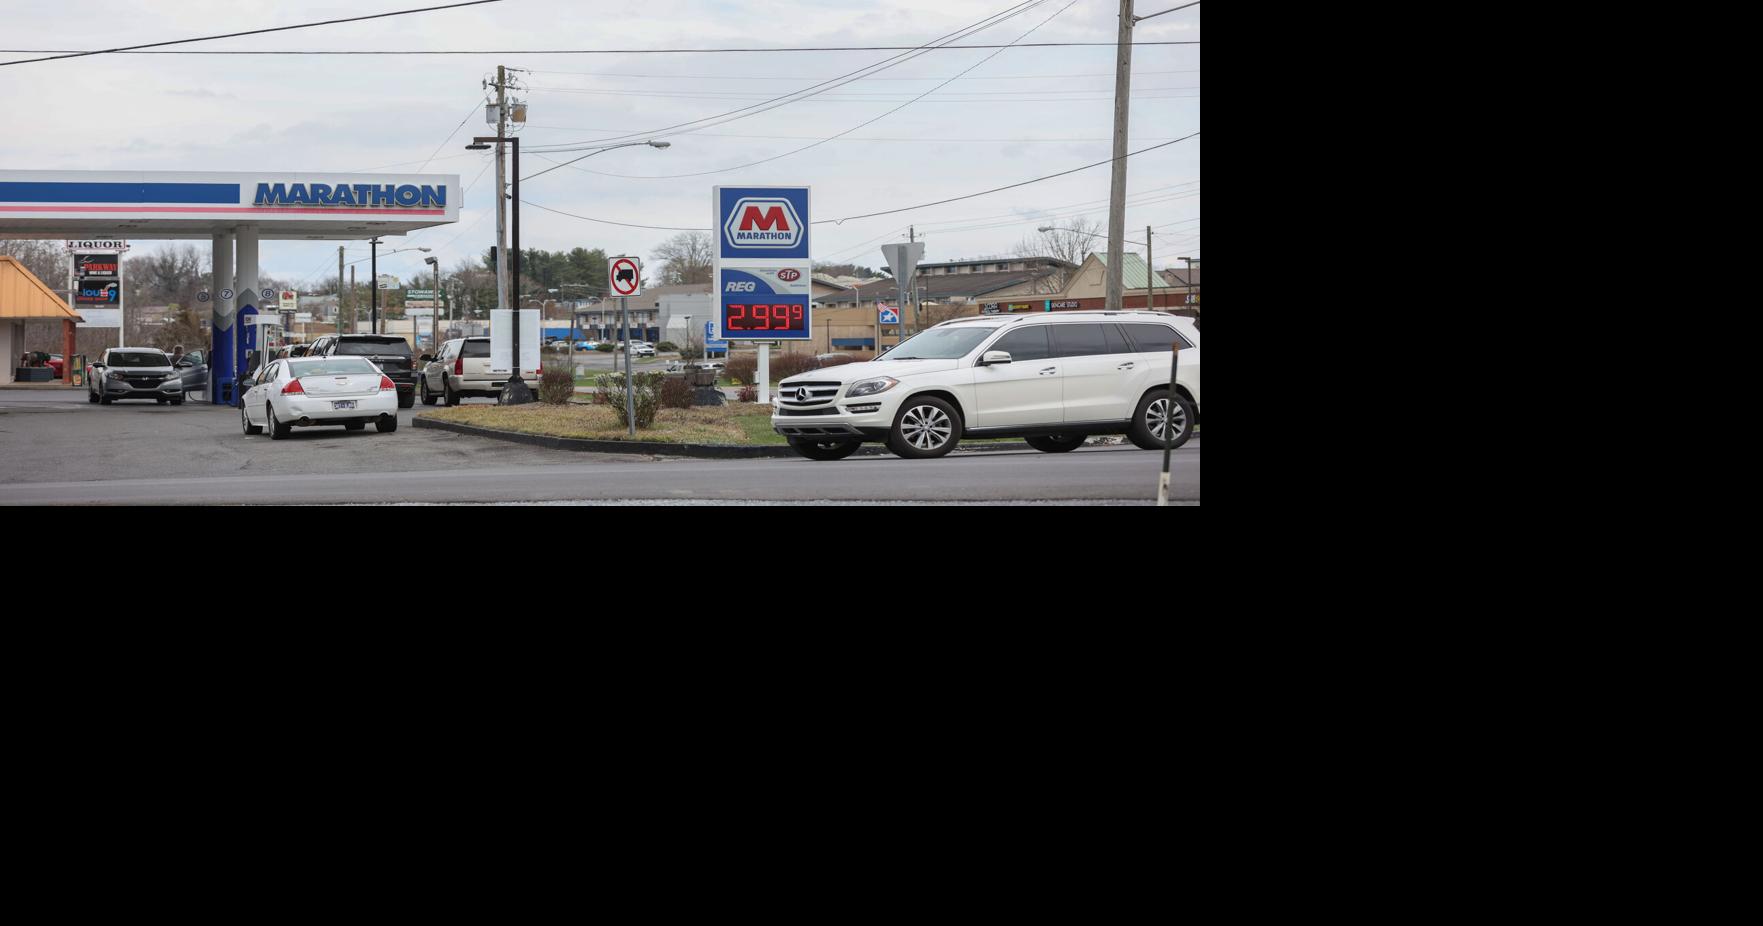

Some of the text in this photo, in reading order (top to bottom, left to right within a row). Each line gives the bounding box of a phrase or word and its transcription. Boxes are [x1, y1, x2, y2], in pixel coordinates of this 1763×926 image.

[254, 183, 447, 208] MARATHON
[739, 206, 790, 231] M
[736, 232, 792, 240] MARATHON
[780, 270, 798, 280] STP
[725, 281, 756, 292] REG
